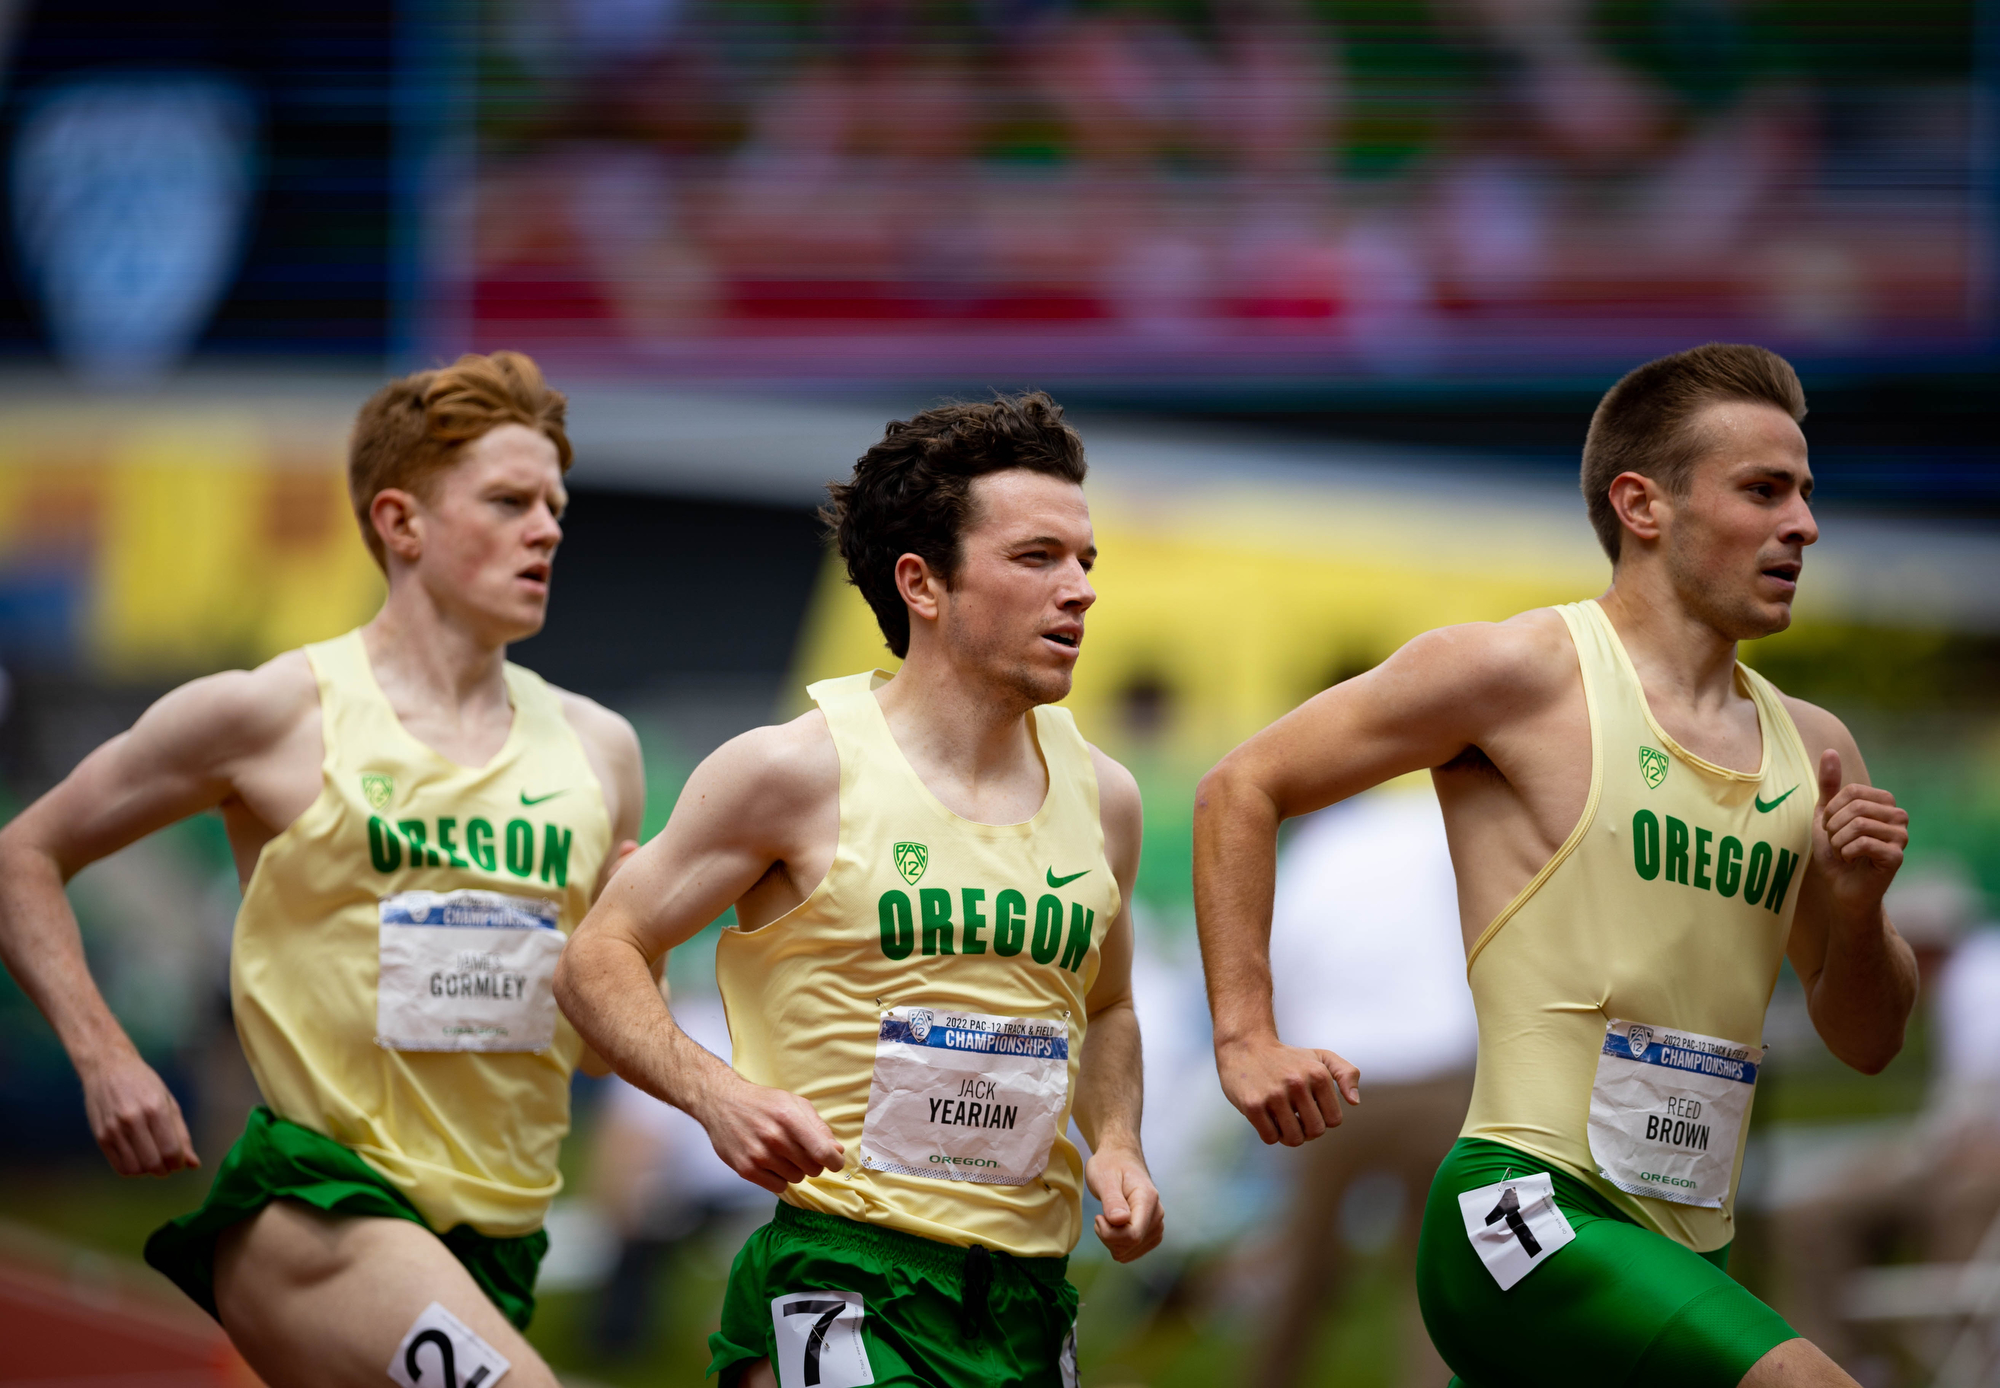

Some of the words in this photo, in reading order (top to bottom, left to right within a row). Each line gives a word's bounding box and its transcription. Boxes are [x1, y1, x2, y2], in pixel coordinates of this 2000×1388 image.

[1642, 749, 1666, 777] PAC
[1646, 765, 1660, 782] 12
[367, 815, 573, 888] OREGON
[896, 844, 926, 868] PAC
[1632, 809, 1799, 915] OREGON
[904, 861, 919, 876] 12
[443, 906, 543, 928] CHAMPION
[878, 888, 1095, 974] OREGON
[430, 973, 527, 999] GORMLEY
[915, 1027, 925, 1036] 12
[946, 1017, 967, 1029] 2022
[970, 1020, 1002, 1033] PAC-12
[1004, 1024, 1026, 1035] TRACK
[1028, 1025, 1033, 1036] &
[1035, 1026, 1054, 1037] FIELD
[945, 1030, 1052, 1056] CHAMPIONSHIPS
[1633, 1042, 1643, 1052] 12
[1663, 1034, 1681, 1047] 2022
[1682, 1037, 1707, 1052] PAC-12
[1707, 1043, 1727, 1056] TRACK
[1727, 1048, 1732, 1056] &
[1732, 1049, 1749, 1060] FIELD
[1660, 1047, 1744, 1080] CHAMPIONSHIPS
[957, 1079, 997, 1100] JACK
[929, 1097, 1018, 1130] YEARIAN
[1667, 1096, 1702, 1120] REED
[1646, 1114, 1710, 1150] BROWN
[929, 1155, 998, 1168] OREGON
[1640, 1171, 1697, 1189] OREGON
[1484, 1187, 1543, 1259] 1
[783, 1300, 846, 1387] 7
[405, 1328, 491, 1388] 2
